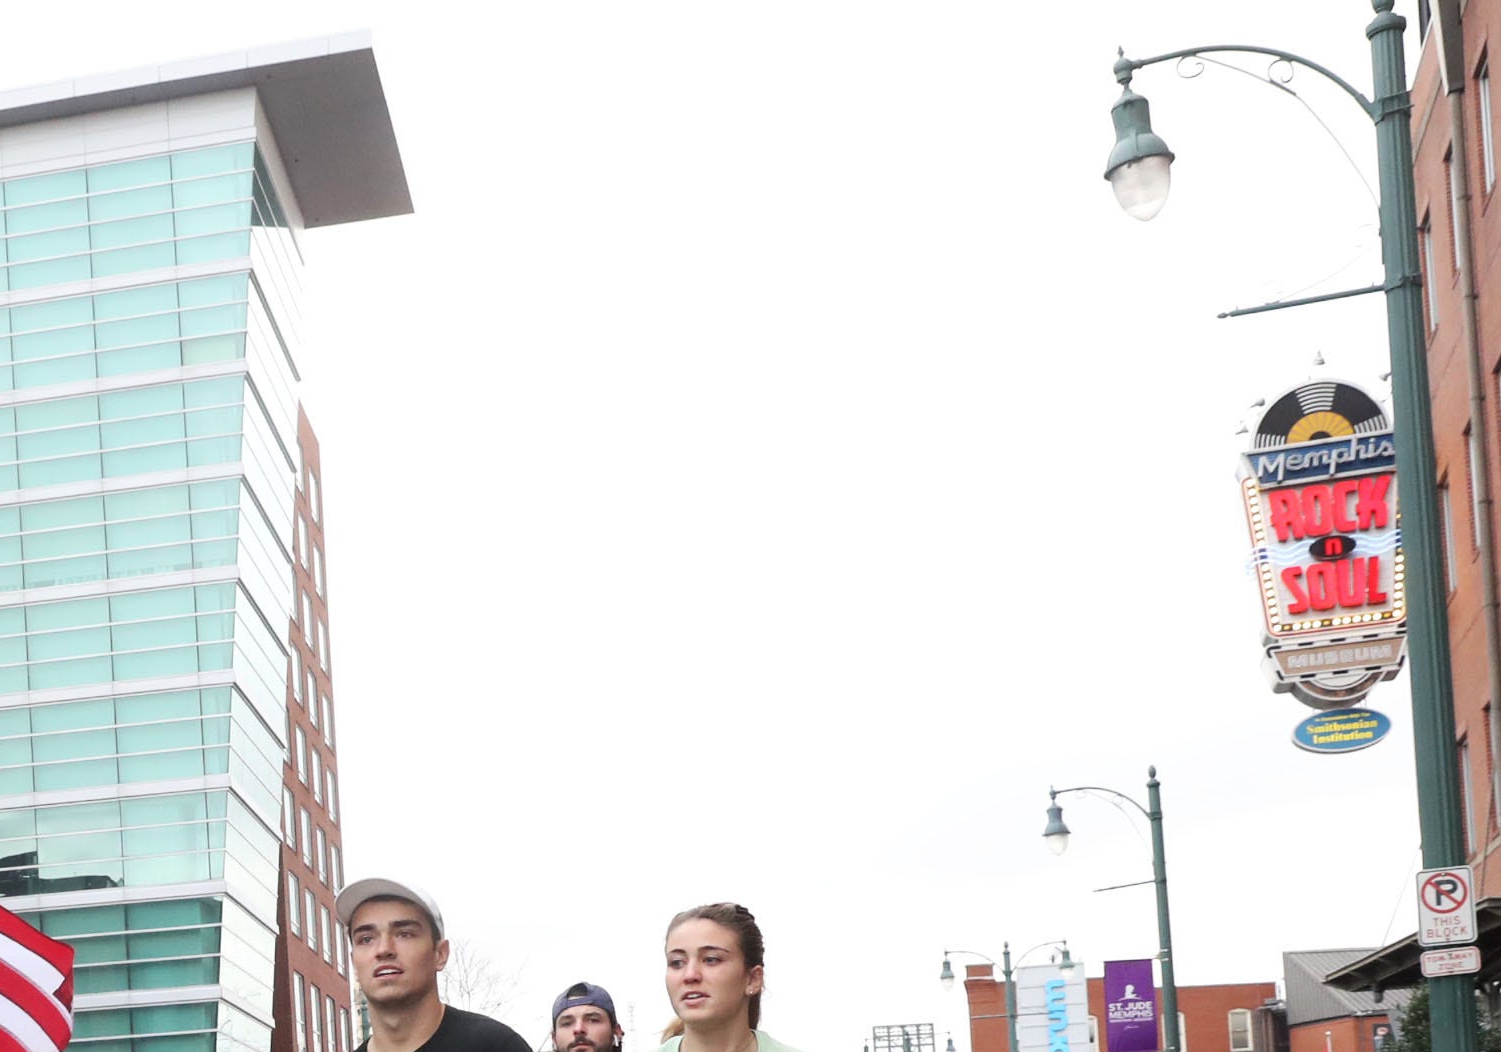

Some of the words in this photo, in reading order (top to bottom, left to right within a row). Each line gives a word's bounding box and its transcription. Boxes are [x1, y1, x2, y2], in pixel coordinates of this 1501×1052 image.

[1257, 437, 1395, 481] Memphis
[1269, 475, 1391, 543] ROCK
[1281, 556, 1388, 614] SOUL
[1287, 644, 1392, 668] MUSEUM
[1306, 719, 1378, 734] Smithsonian
[1313, 730, 1374, 744] Institution
[1433, 915, 1461, 927] THIS
[1426, 926, 1468, 938] BLOCK
[1438, 962, 1464, 970] ZONE
[1108, 1002, 1123, 1012] ST.
[1125, 1000, 1153, 1011] JUDE
[1109, 1009, 1154, 1019] MEMPHIS
